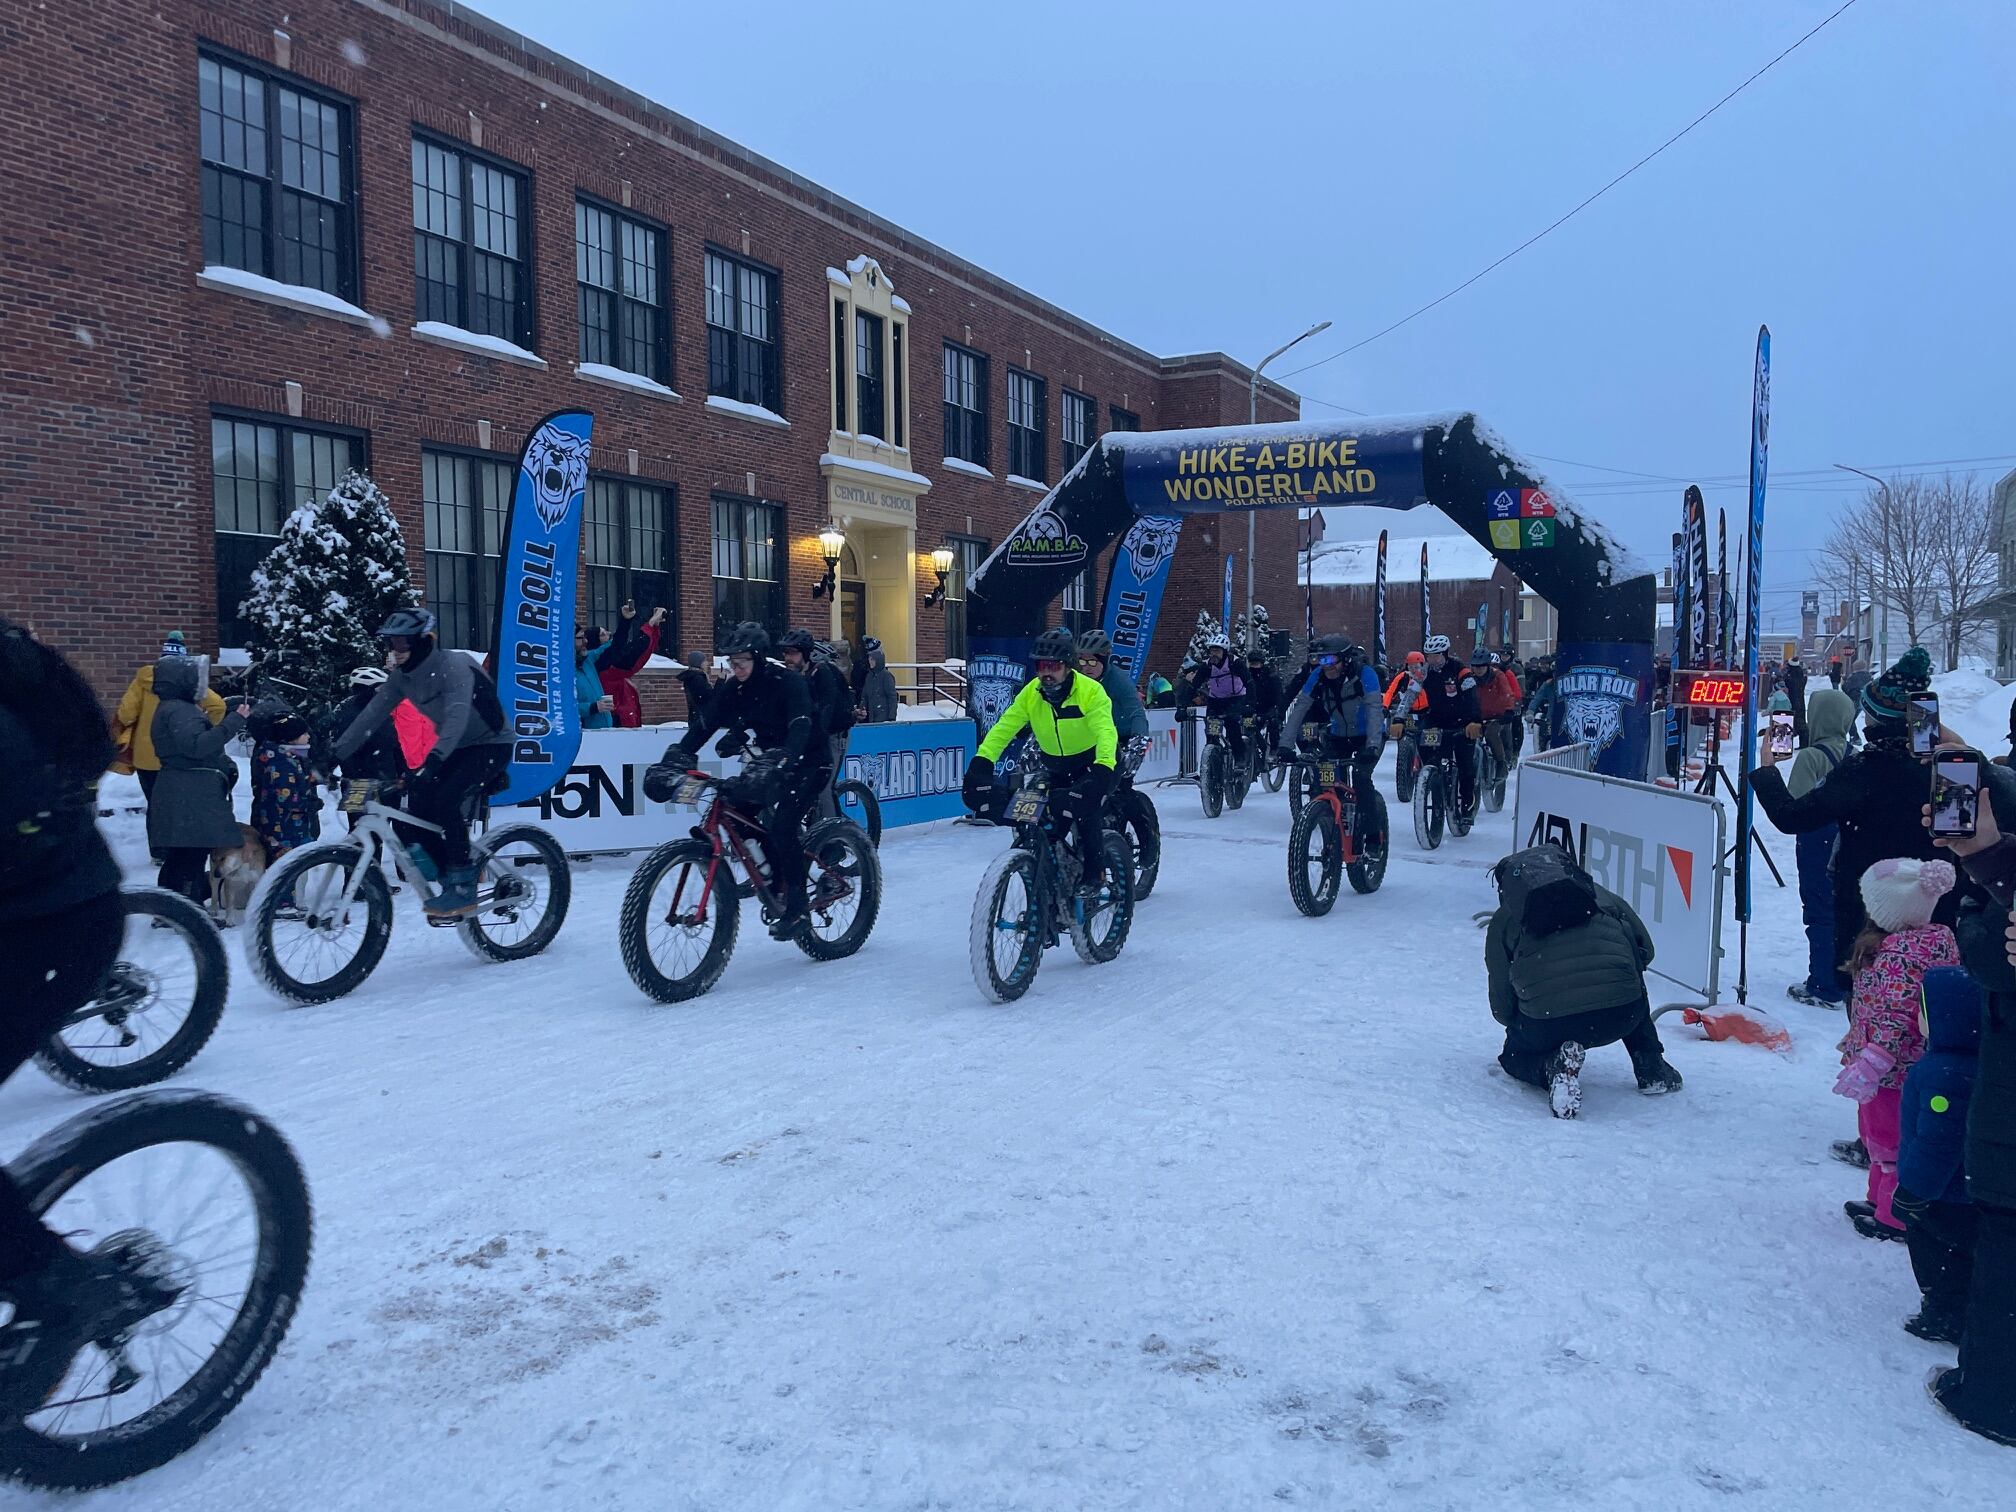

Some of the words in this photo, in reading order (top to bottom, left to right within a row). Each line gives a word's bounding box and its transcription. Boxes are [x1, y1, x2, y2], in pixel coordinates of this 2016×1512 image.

[1179, 439, 1358, 475] HIKE-A-BIKE
[834, 484, 878, 505] CENTRAL
[881, 494, 913, 512] SCHOOL
[1164, 468, 1376, 502] WONDERLAND
[1225, 497, 1267, 507] POLAR
[1269, 495, 1302, 505] ROLL
[517, 540, 557, 632] ROLL
[554, 570, 563, 602] RACE
[1112, 590, 1148, 648] ROLL
[1143, 608, 1153, 630] RACE
[551, 608, 561, 684] ADVENTURE
[996, 662, 1023, 681] ROLL
[1557, 675, 1598, 696] POLAR
[1601, 676, 1636, 699] ROLL
[513, 640, 553, 765] POLAR
[551, 689, 566, 736] WINTER
[920, 746, 966, 796] ROLL
[1013, 800, 1037, 815] 549
